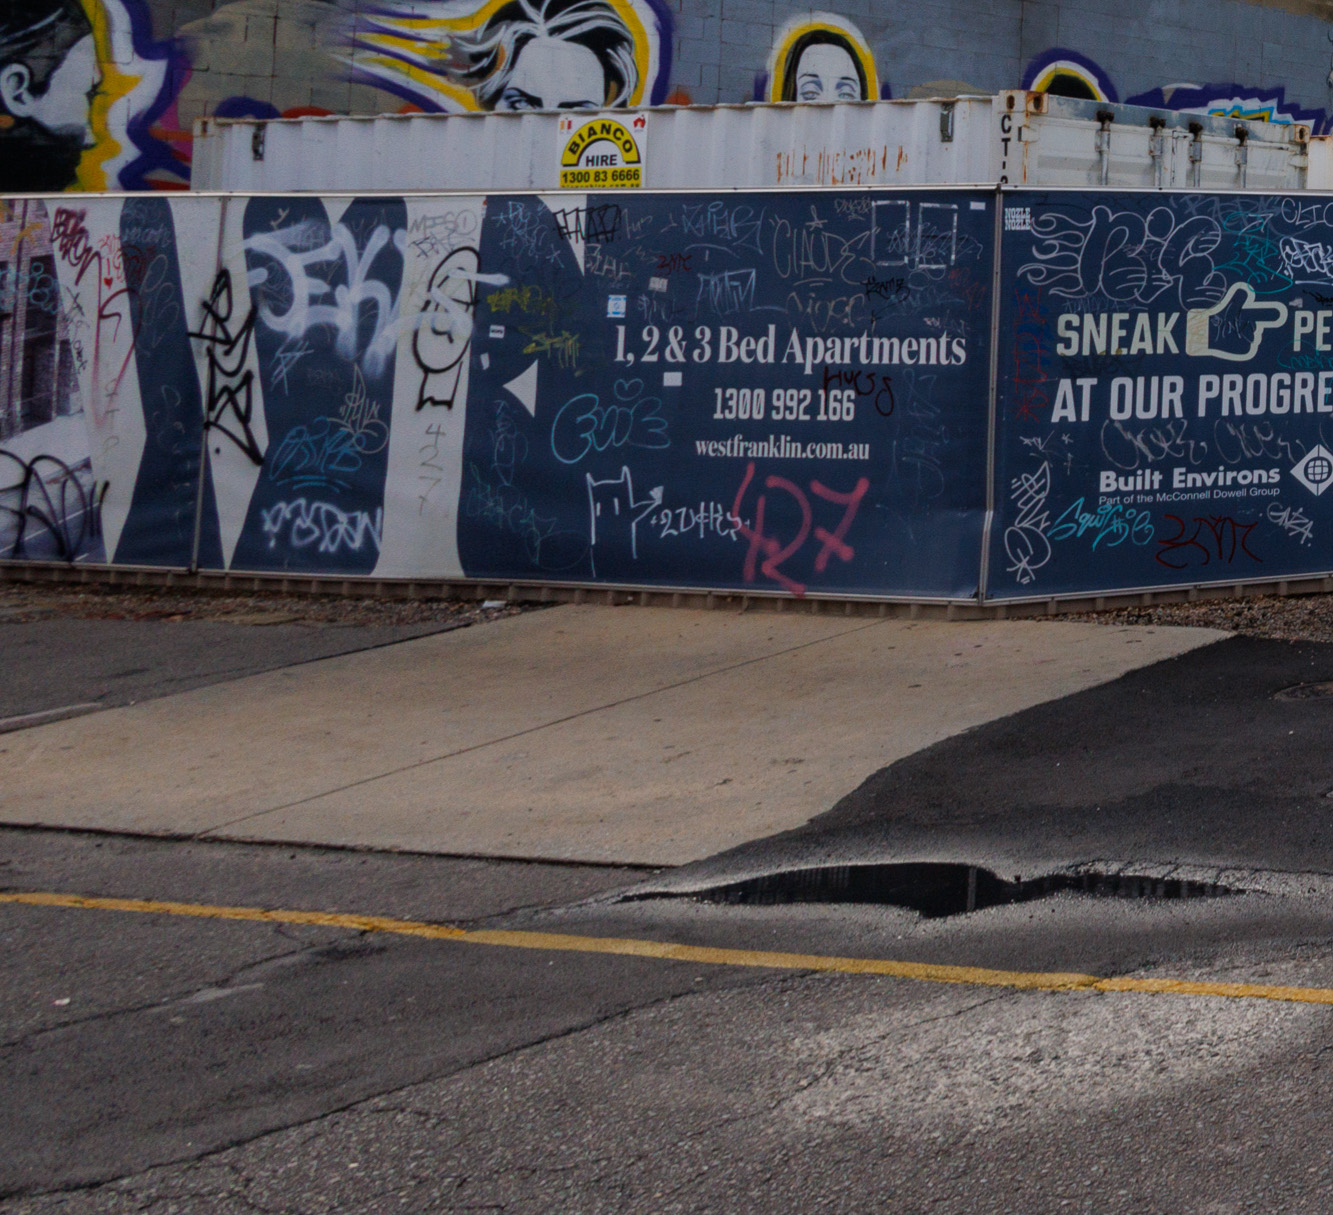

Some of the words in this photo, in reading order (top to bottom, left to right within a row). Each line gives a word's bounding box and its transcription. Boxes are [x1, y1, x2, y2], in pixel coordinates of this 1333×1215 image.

[568, 123, 633, 156] BIANCO
[585, 154, 618, 167] HIRE
[562, 171, 591, 184] 1300
[594, 170, 608, 183] 83
[611, 169, 640, 182] 6666
[1056, 312, 1181, 357] SNEAK
[614, 325, 635, 367] 1,
[640, 325, 661, 364] 2
[664, 325, 687, 364] &
[693, 325, 712, 364] 3
[717, 324, 776, 364] Bed
[781, 327, 967, 376] Apartments
[713, 388, 765, 420] 1300
[771, 388, 811, 421] 992
[816, 389, 856, 421] 166
[1051, 377, 1098, 423] AT
[1109, 375, 1184, 420] OUR
[695, 434, 871, 460] westfranklin.com.au
[1100, 469, 1163, 493] Built
[1173, 466, 1281, 488] Environs
[1099, 495, 1120, 506] Part
[1123, 493, 1135, 504] of
[1137, 492, 1153, 503] the
[1156, 490, 1211, 502] McConnell
[1213, 488, 1247, 500] Dowell
[1249, 486, 1281, 498] Group
